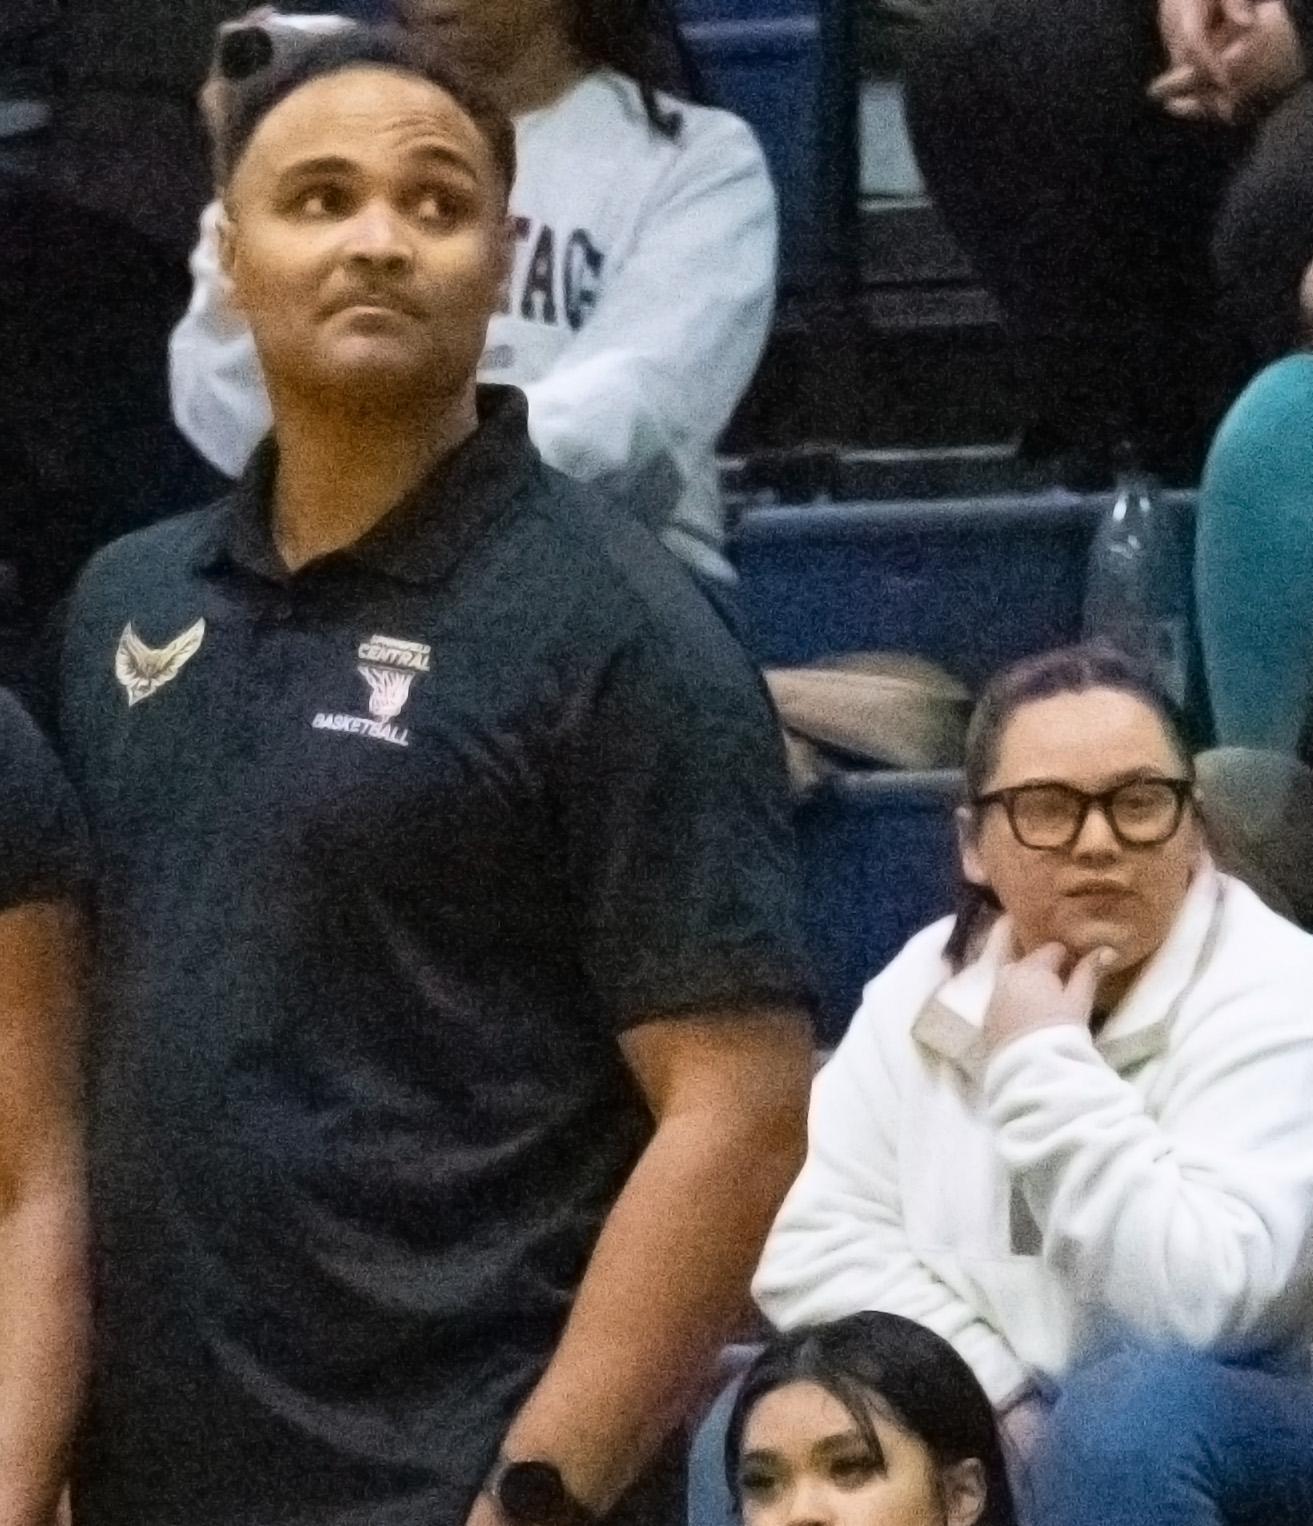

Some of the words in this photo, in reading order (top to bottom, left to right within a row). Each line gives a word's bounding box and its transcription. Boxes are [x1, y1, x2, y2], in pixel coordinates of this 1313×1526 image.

[511, 216, 604, 332] AG
[358, 643, 430, 671] CENTRAL
[312, 712, 409, 746] BASKETBALL
